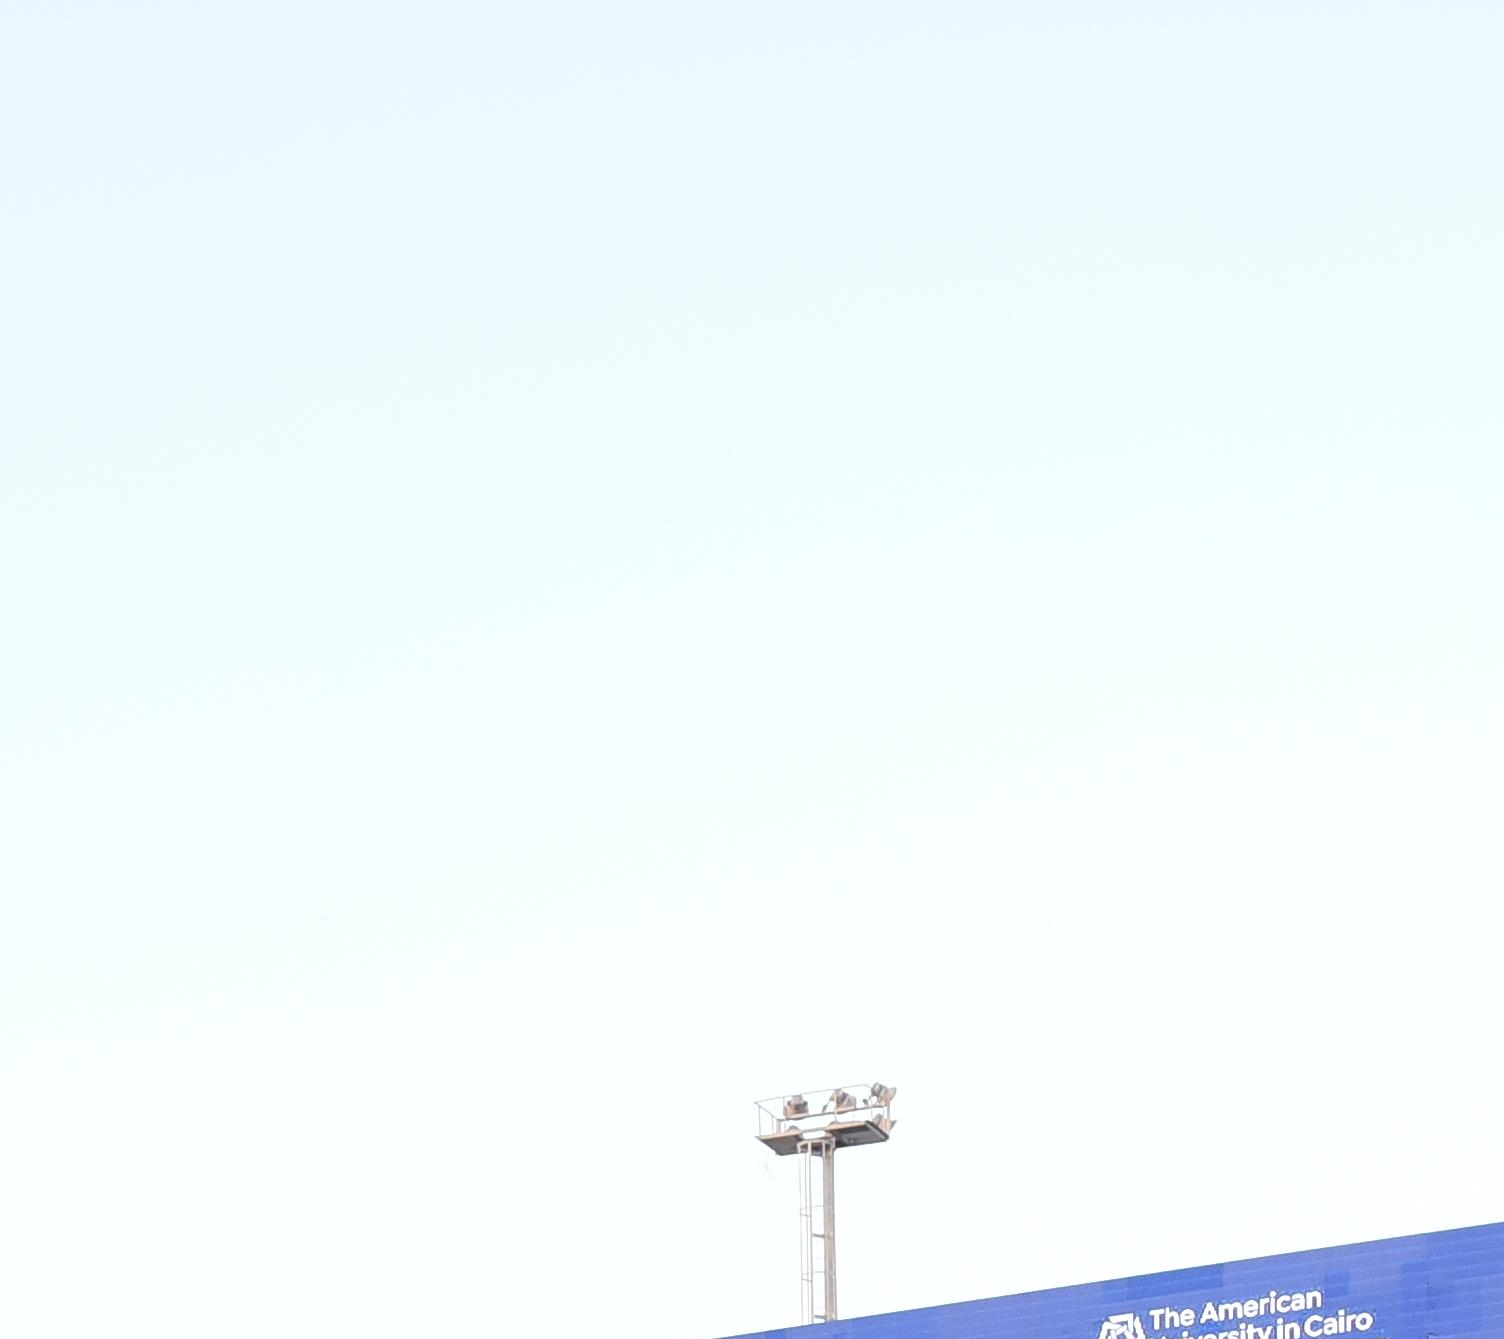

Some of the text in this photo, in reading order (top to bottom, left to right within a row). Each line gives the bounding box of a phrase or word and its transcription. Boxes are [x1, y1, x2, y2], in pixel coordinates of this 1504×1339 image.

[1148, 1290, 1322, 1331] The American
[1303, 1309, 1374, 1338] Cairo
